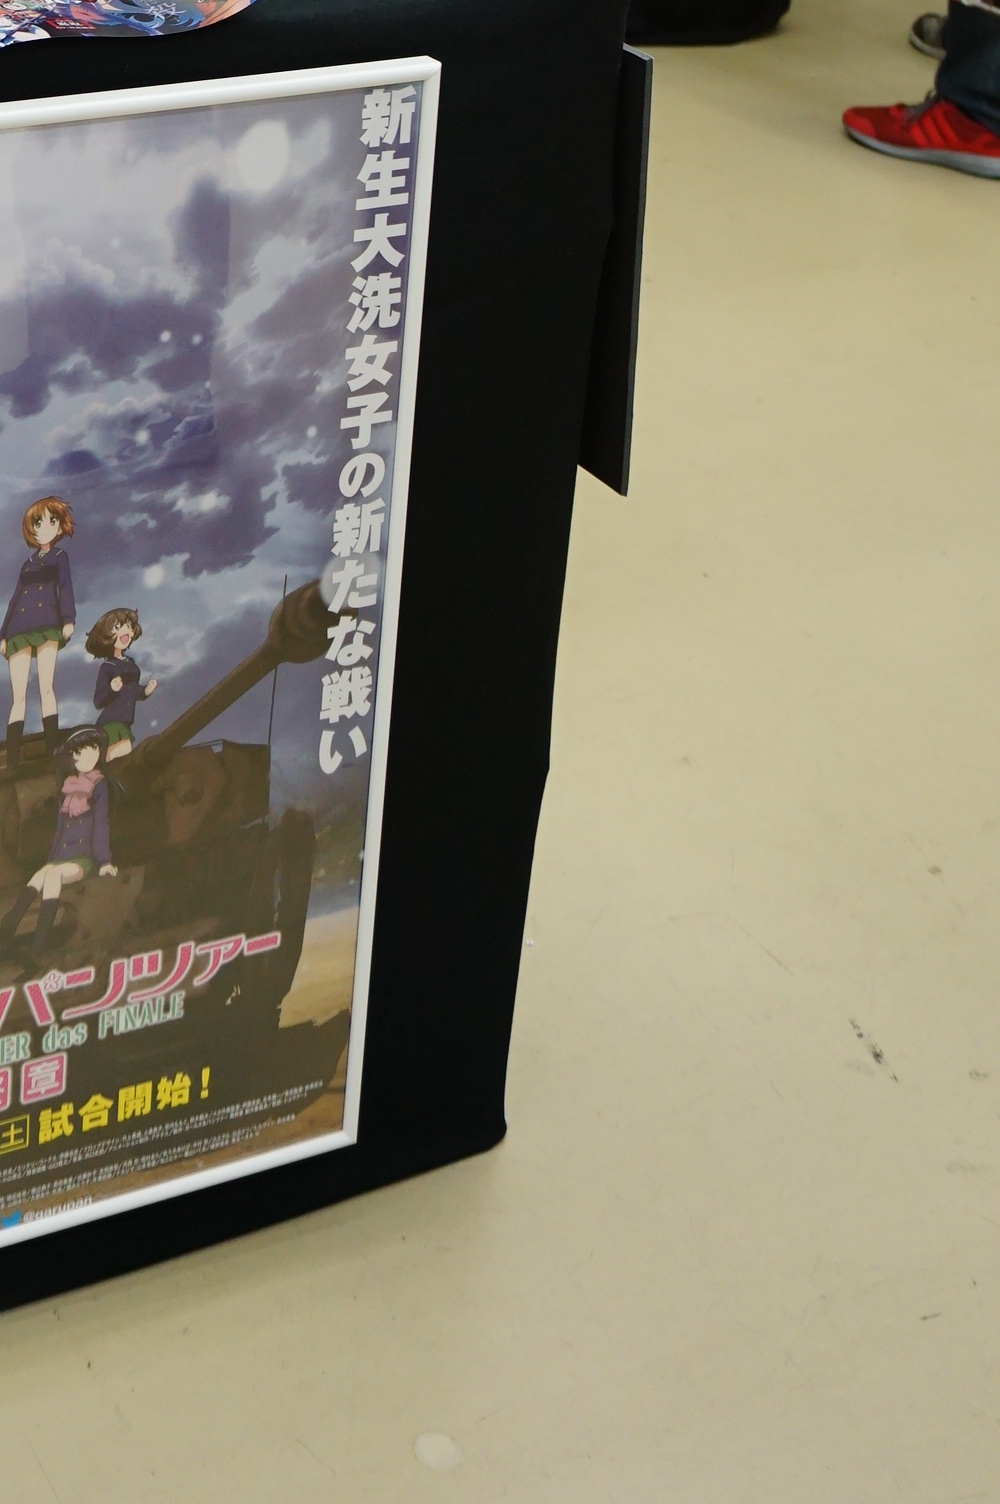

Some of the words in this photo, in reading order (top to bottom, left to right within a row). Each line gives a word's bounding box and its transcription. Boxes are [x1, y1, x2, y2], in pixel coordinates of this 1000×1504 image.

[318, 84, 416, 775] 新生大洗女子の新たな戦い
[42, 1022, 89, 1054] das
[98, 991, 186, 1040] FINALE
[38, 1066, 211, 1145] 試合開始!
